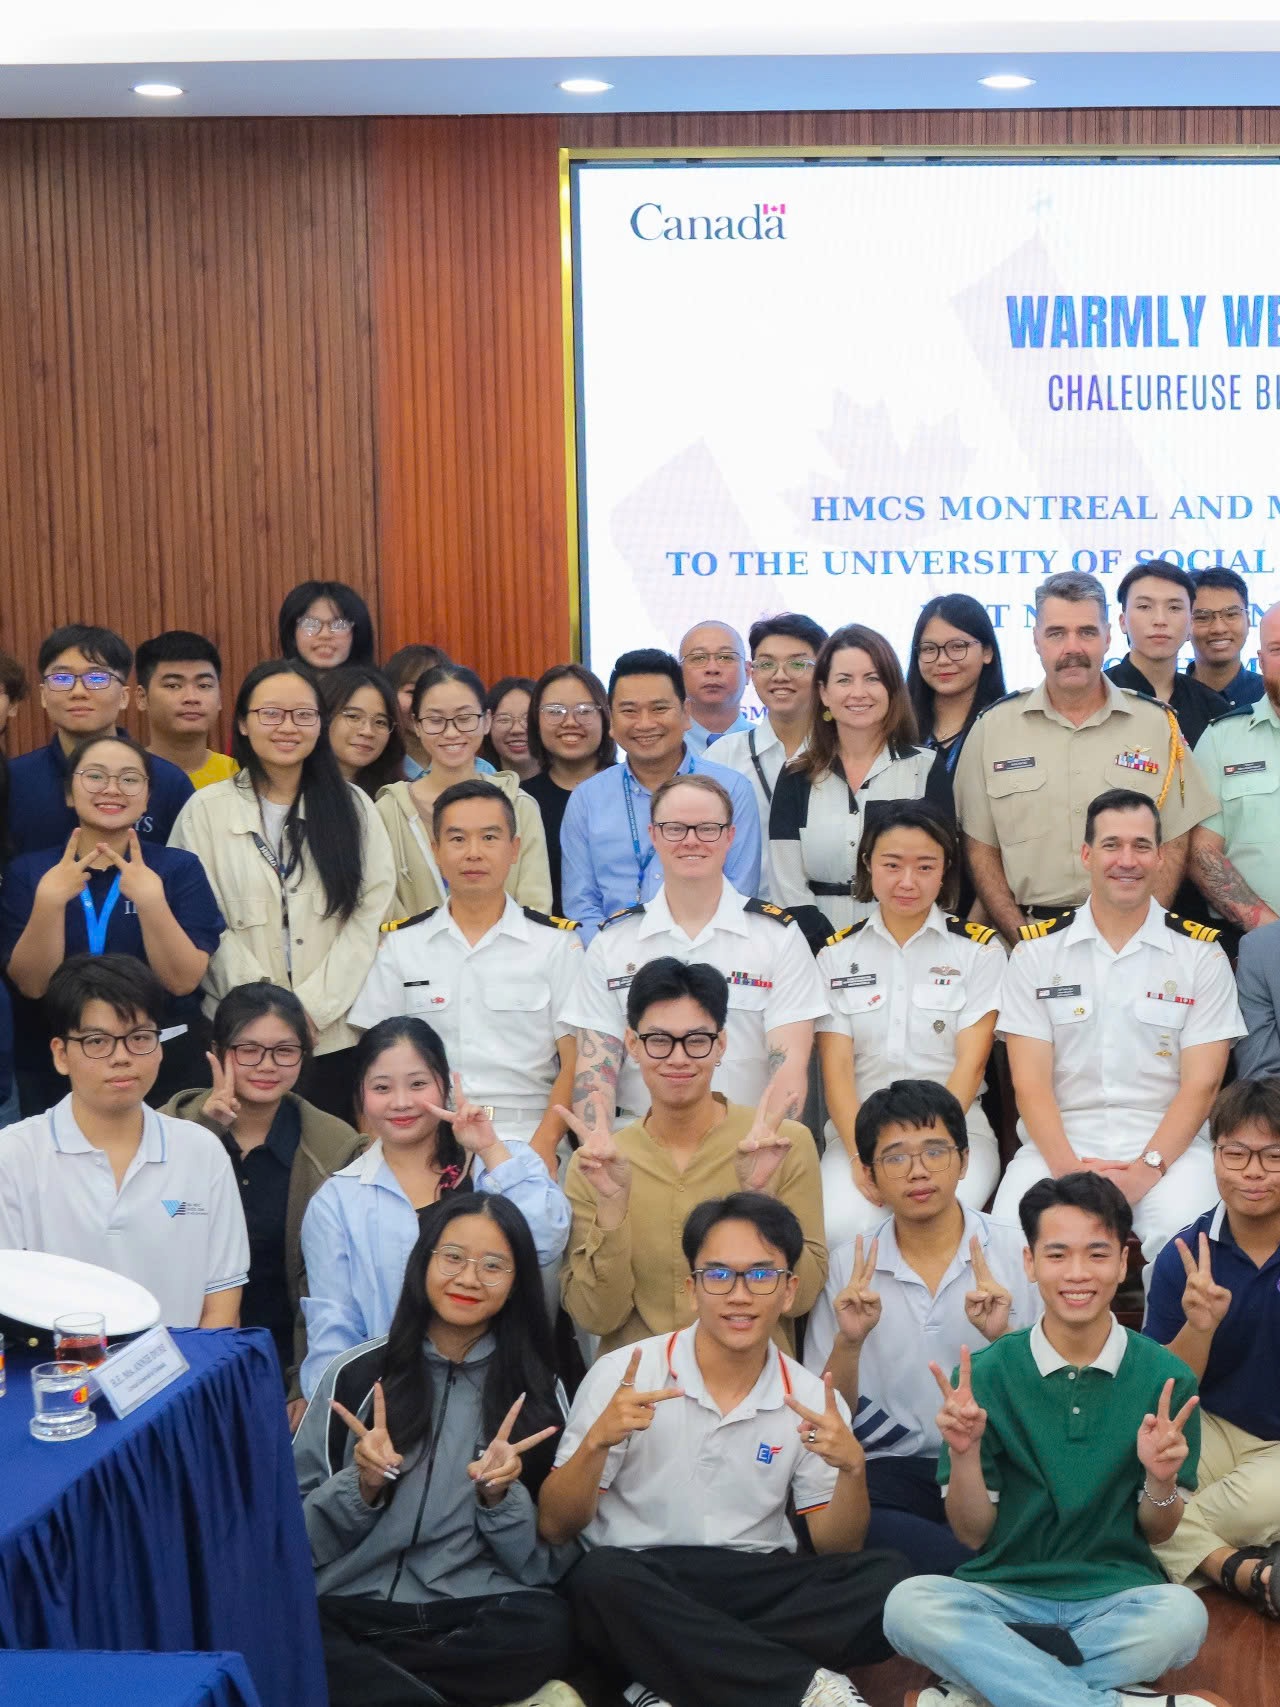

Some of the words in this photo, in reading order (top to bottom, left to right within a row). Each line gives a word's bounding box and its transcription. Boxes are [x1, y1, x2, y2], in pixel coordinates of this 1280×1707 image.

[630, 203, 786, 241] Canada
[1006, 294, 1206, 349] WARMLY
[1047, 374, 1242, 411] CHALEUREUSE
[811, 495, 926, 521] HMCS
[939, 494, 1158, 521] MONTREAL
[1169, 494, 1254, 520] AND
[665, 551, 718, 576] TO
[729, 551, 809, 576] THE
[822, 550, 1058, 576] UNIVERSITY
[1071, 549, 1122, 574] OF
[1135, 549, 1274, 573] SOCIAL
